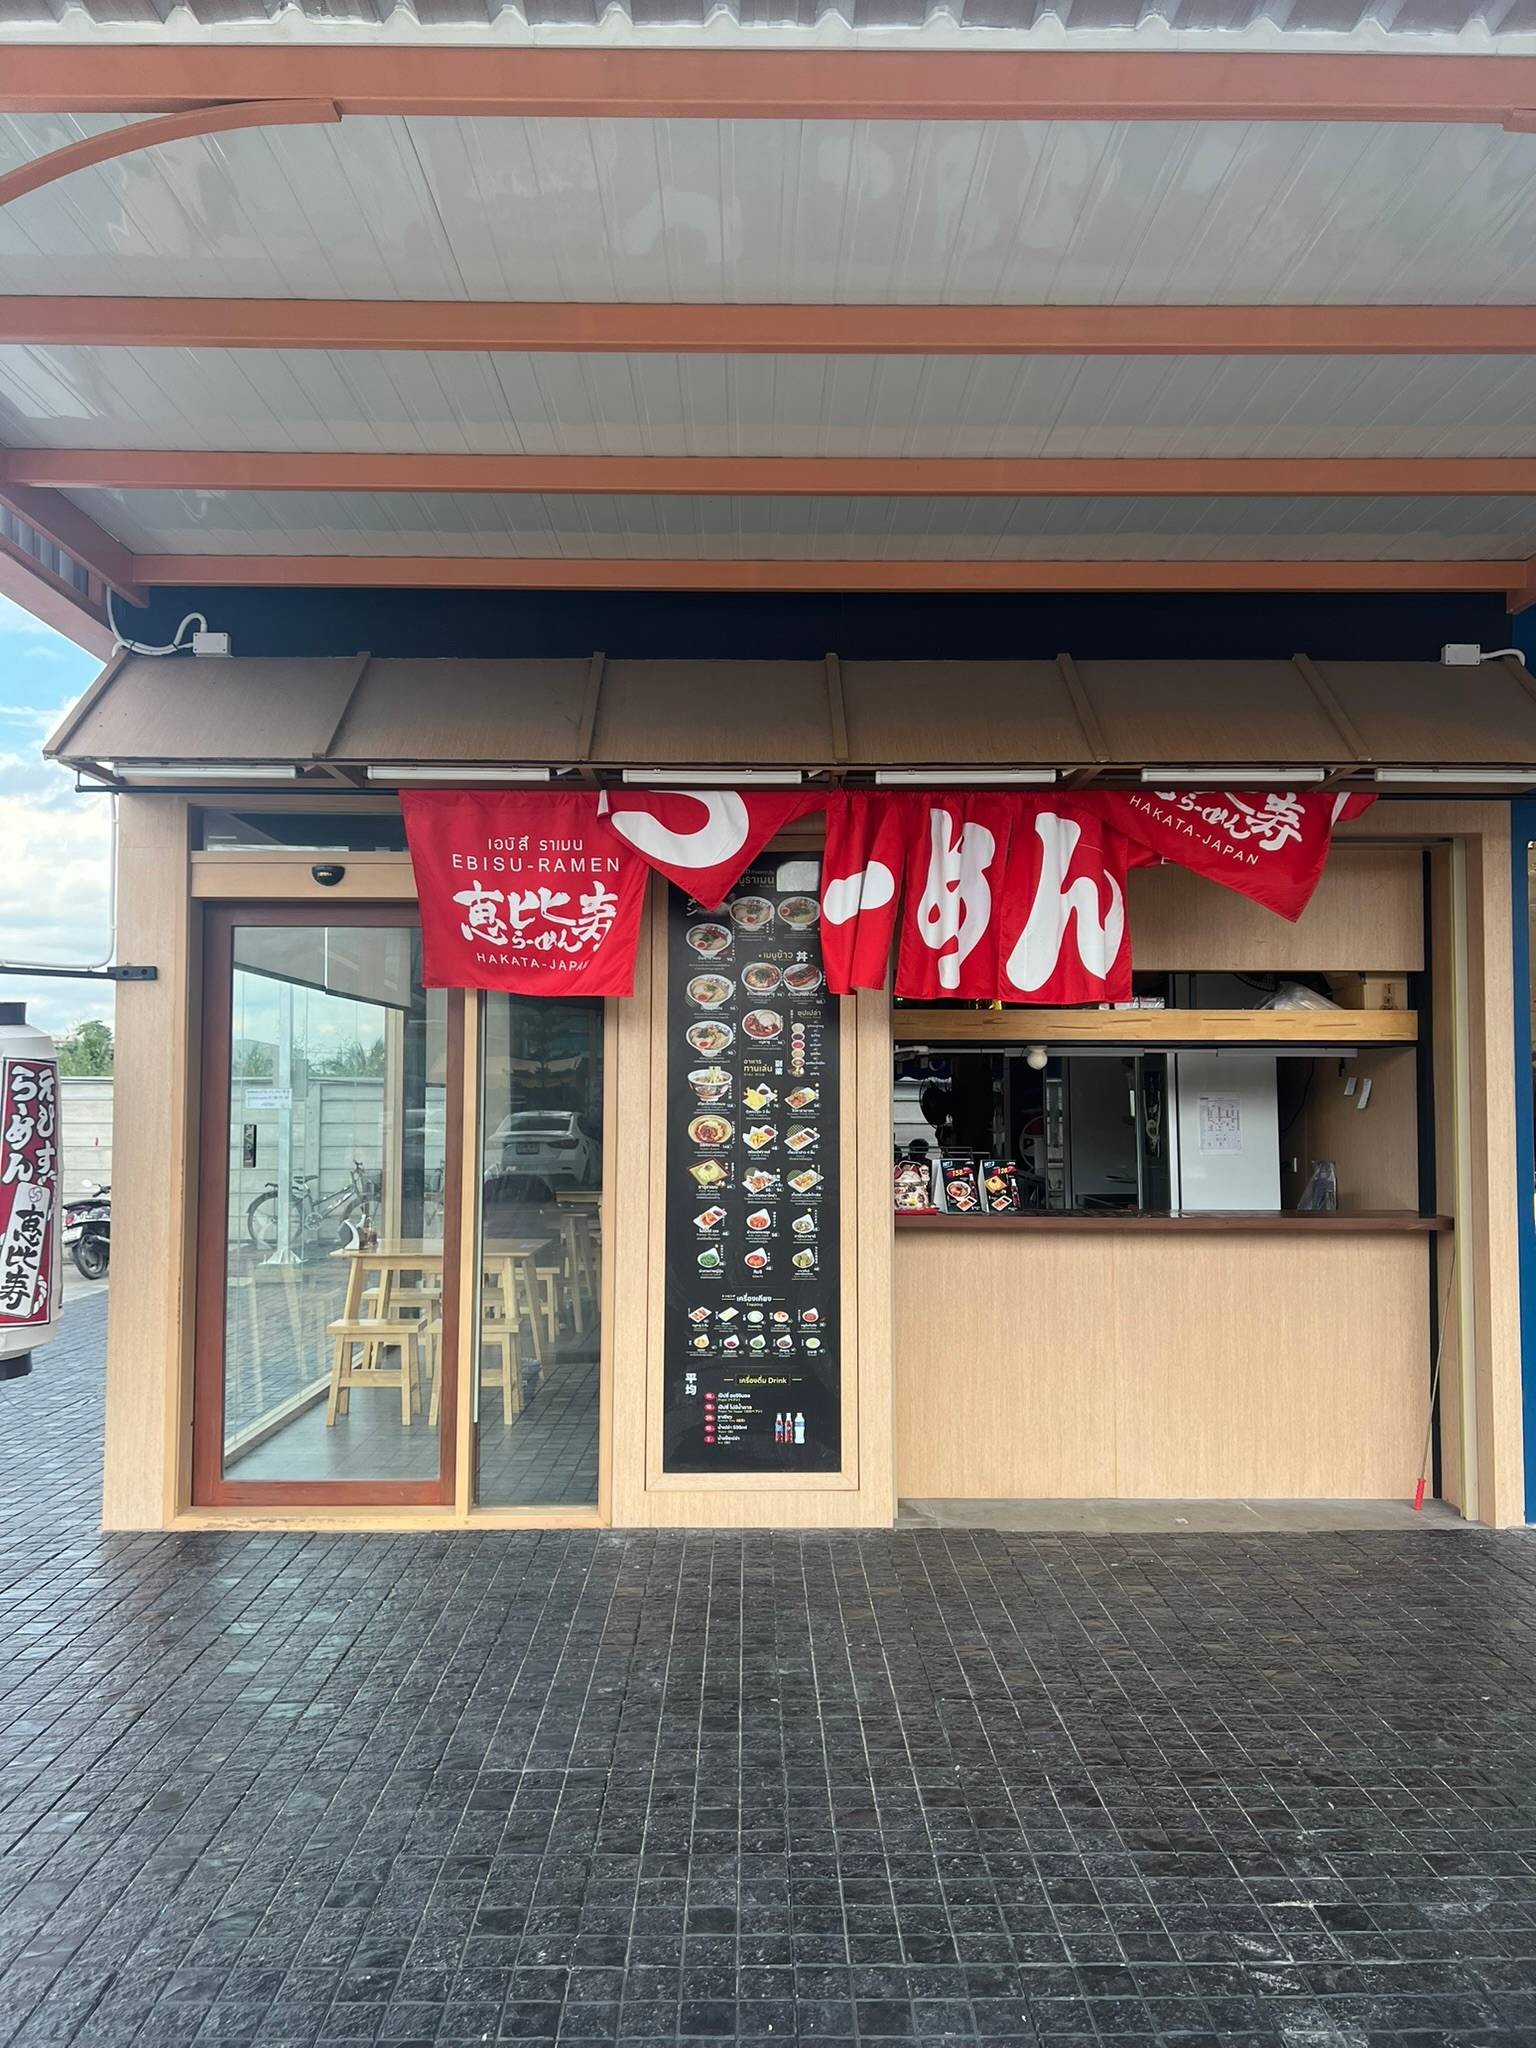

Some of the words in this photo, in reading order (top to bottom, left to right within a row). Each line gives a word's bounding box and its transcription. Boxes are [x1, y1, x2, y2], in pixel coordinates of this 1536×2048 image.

[1129, 795, 1259, 865] HAKATA-JAPAN
[539, 839, 583, 851] ราเมน
[452, 853, 620, 873] EBISU-RAMEN
